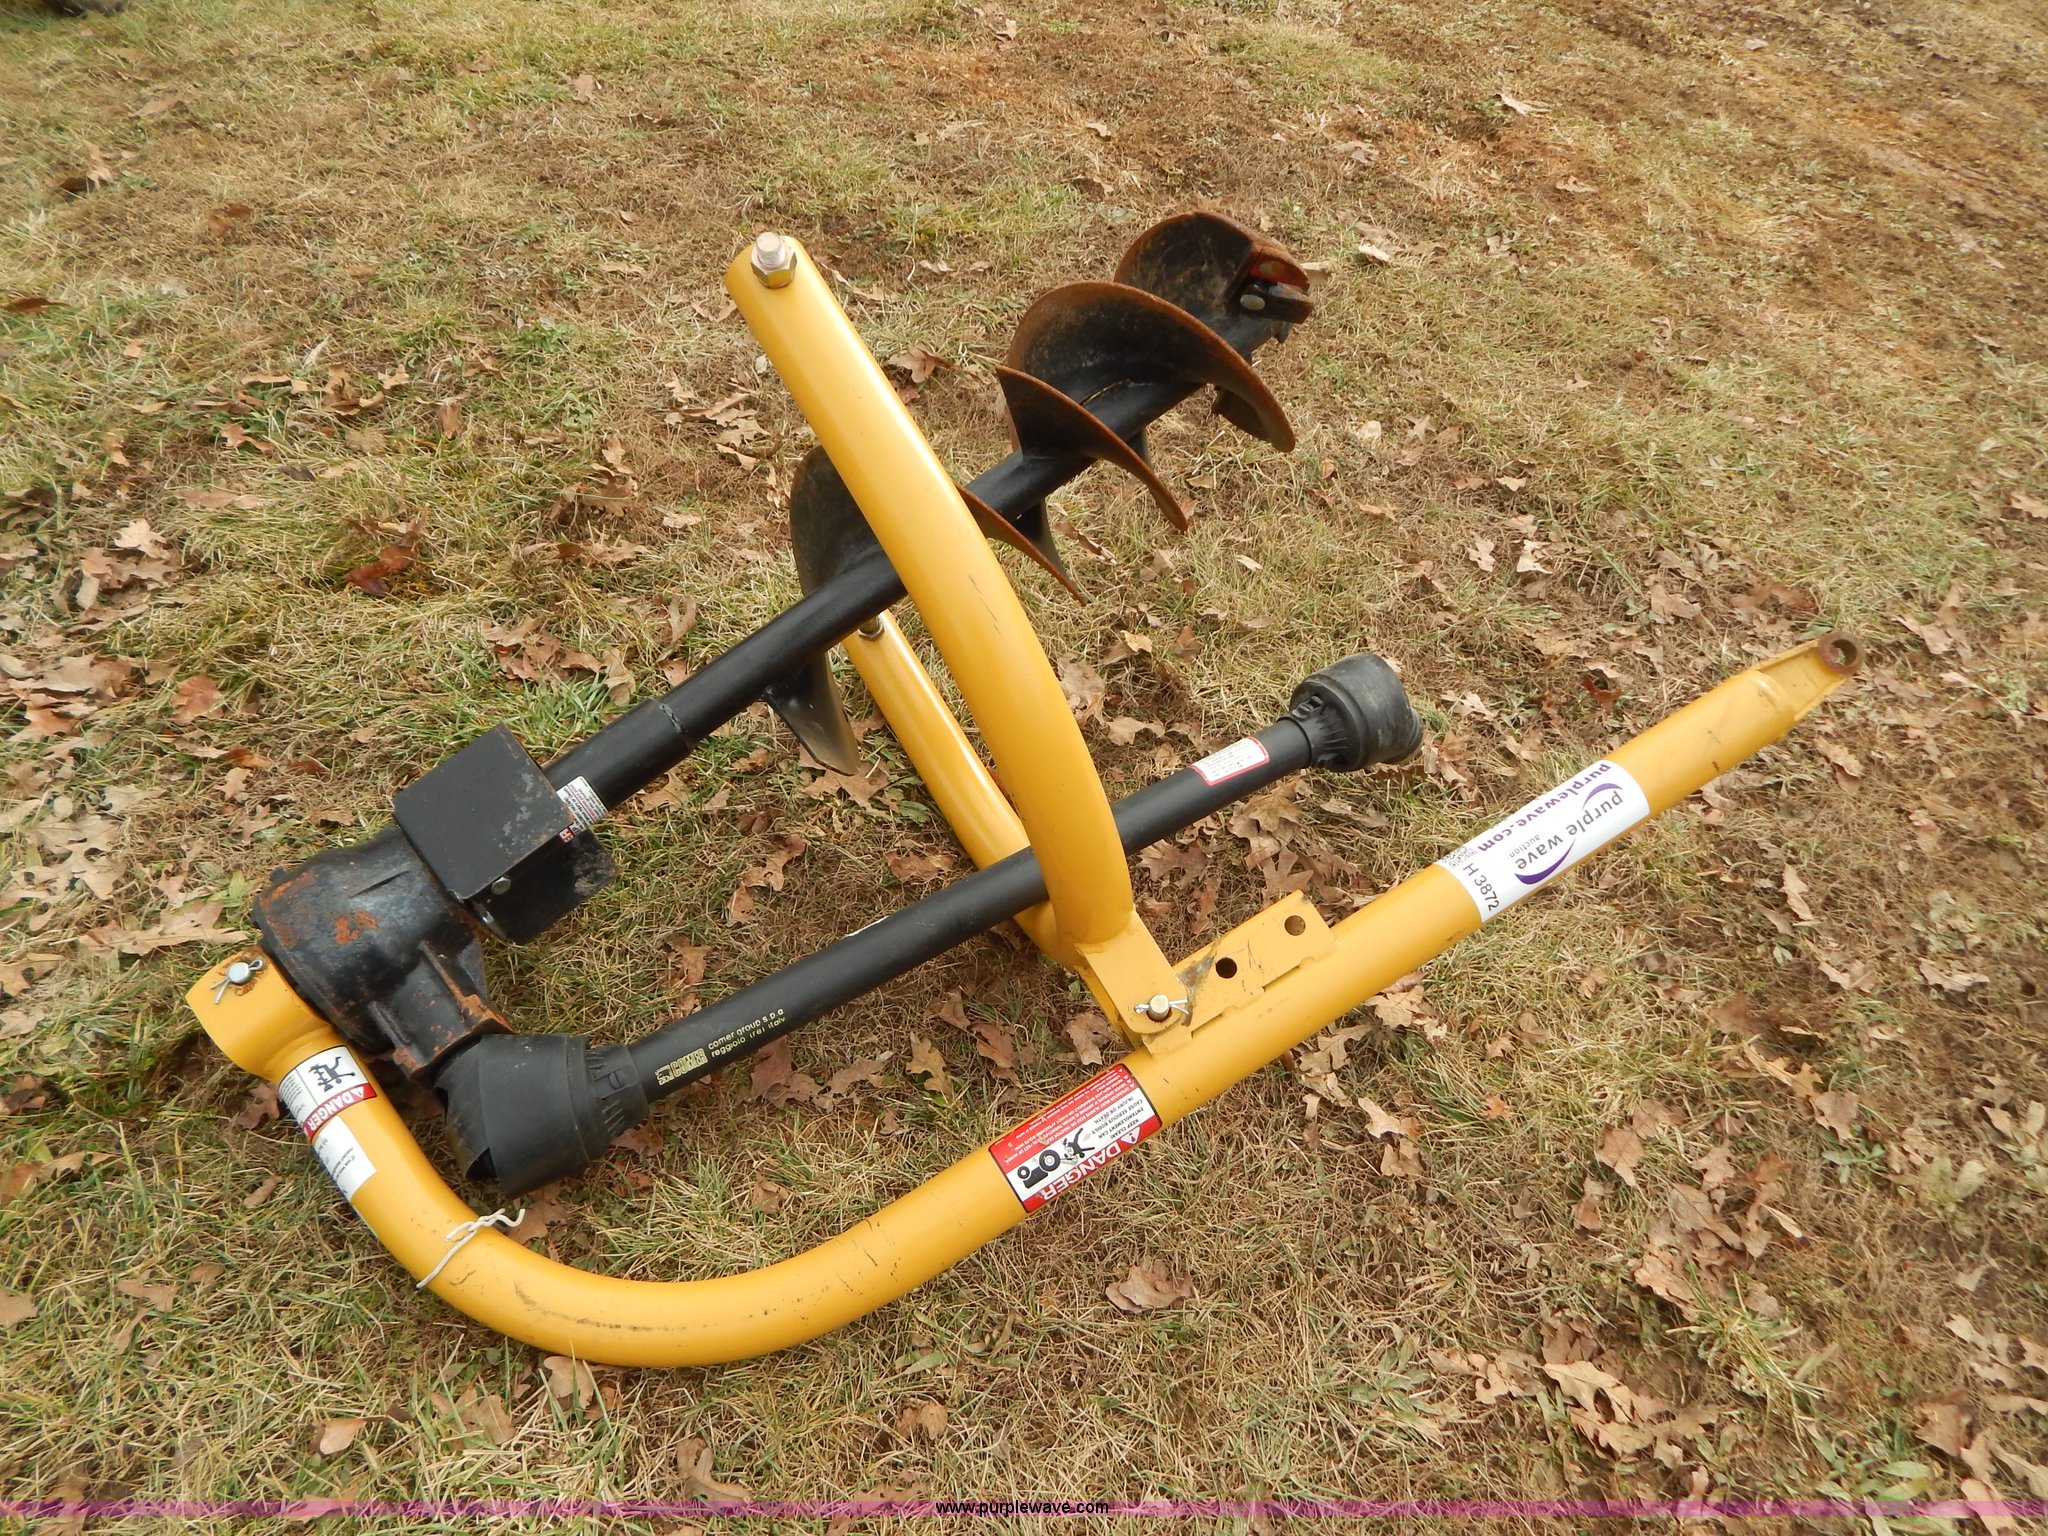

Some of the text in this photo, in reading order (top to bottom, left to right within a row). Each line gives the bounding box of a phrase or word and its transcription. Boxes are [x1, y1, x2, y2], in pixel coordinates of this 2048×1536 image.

[1478, 763, 1612, 852] purplewave.com
[1509, 834, 1540, 858] auction
[1515, 791, 1623, 870] purple wave
[1462, 863, 1500, 912] H 3872
[708, 1031, 735, 1050] comer
[308, 1092, 353, 1131] DANGER
[1127, 1098, 1143, 1110] CAUSE
[1097, 1106, 1144, 1138] ENTANGLEMENT CAN
[1126, 1118, 1139, 1128] KEEP
[1042, 1141, 1122, 1201] DANGER
